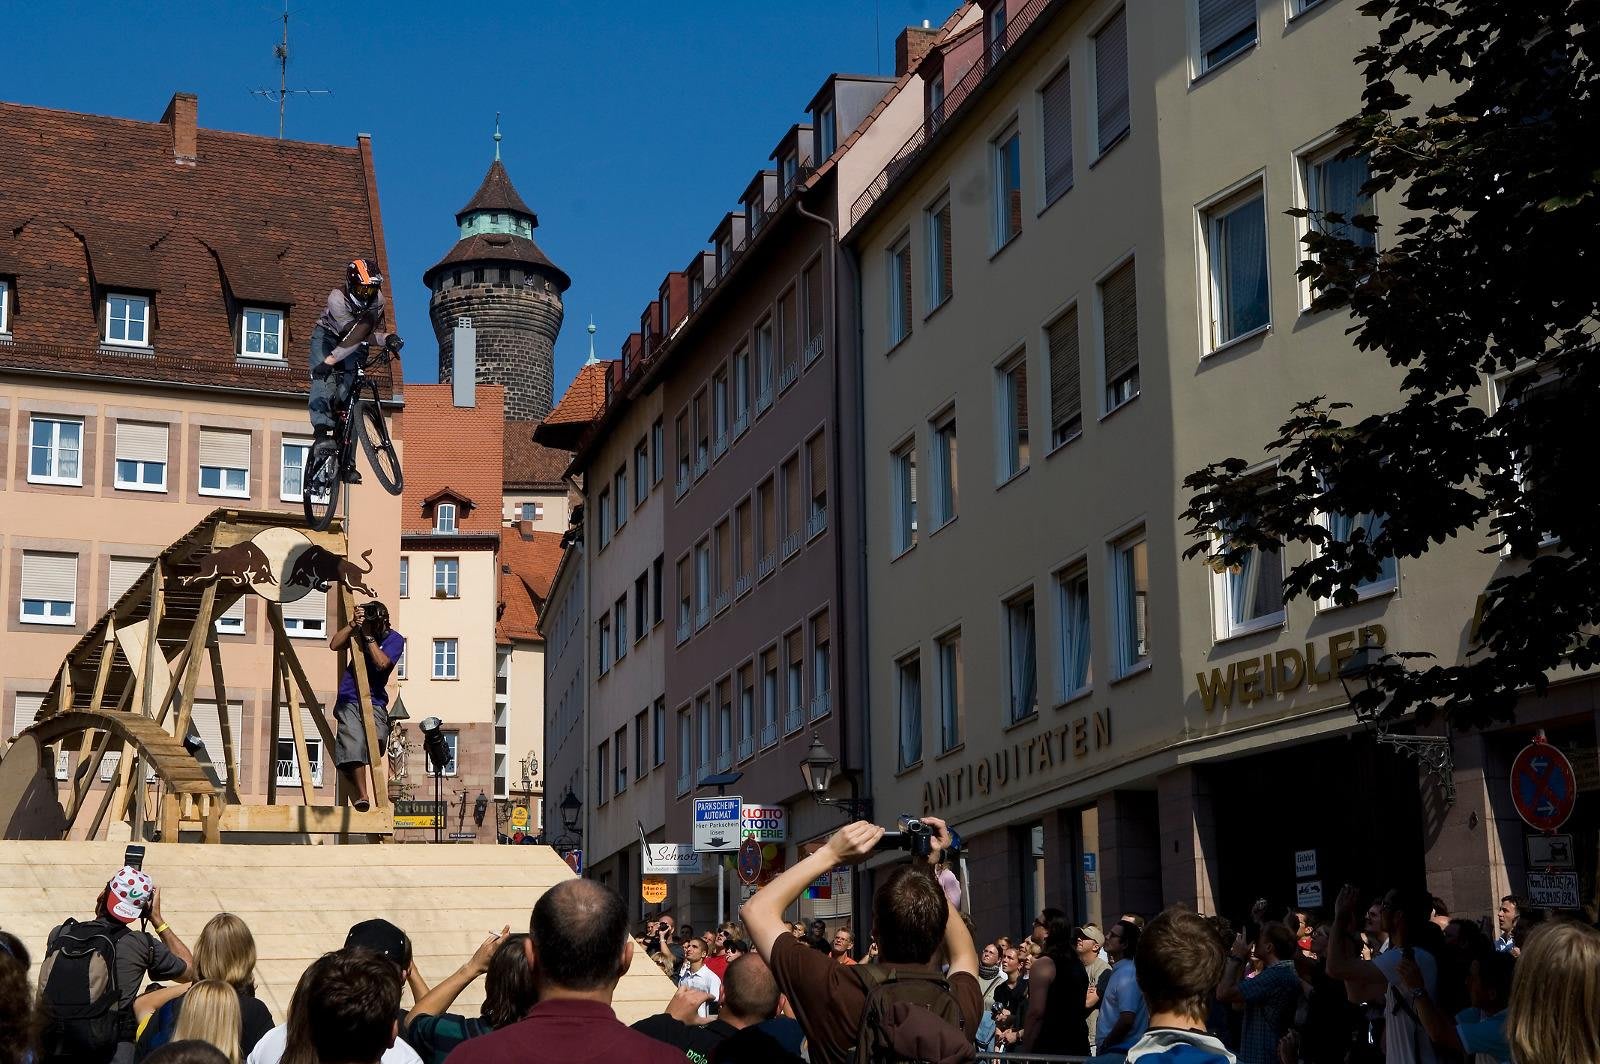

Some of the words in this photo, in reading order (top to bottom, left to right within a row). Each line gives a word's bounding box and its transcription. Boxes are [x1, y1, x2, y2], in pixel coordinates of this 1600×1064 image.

[923, 707, 1111, 816] ANTIQUITÄTEN
[697, 801, 738, 811] PARKSCHEIN-
[704, 811, 732, 820] AUTOMAT
[748, 809, 783, 819] LOTTO
[709, 821, 740, 829] Parkschein
[750, 819, 779, 829] TOTO
[741, 829, 783, 838] OTTERIE
